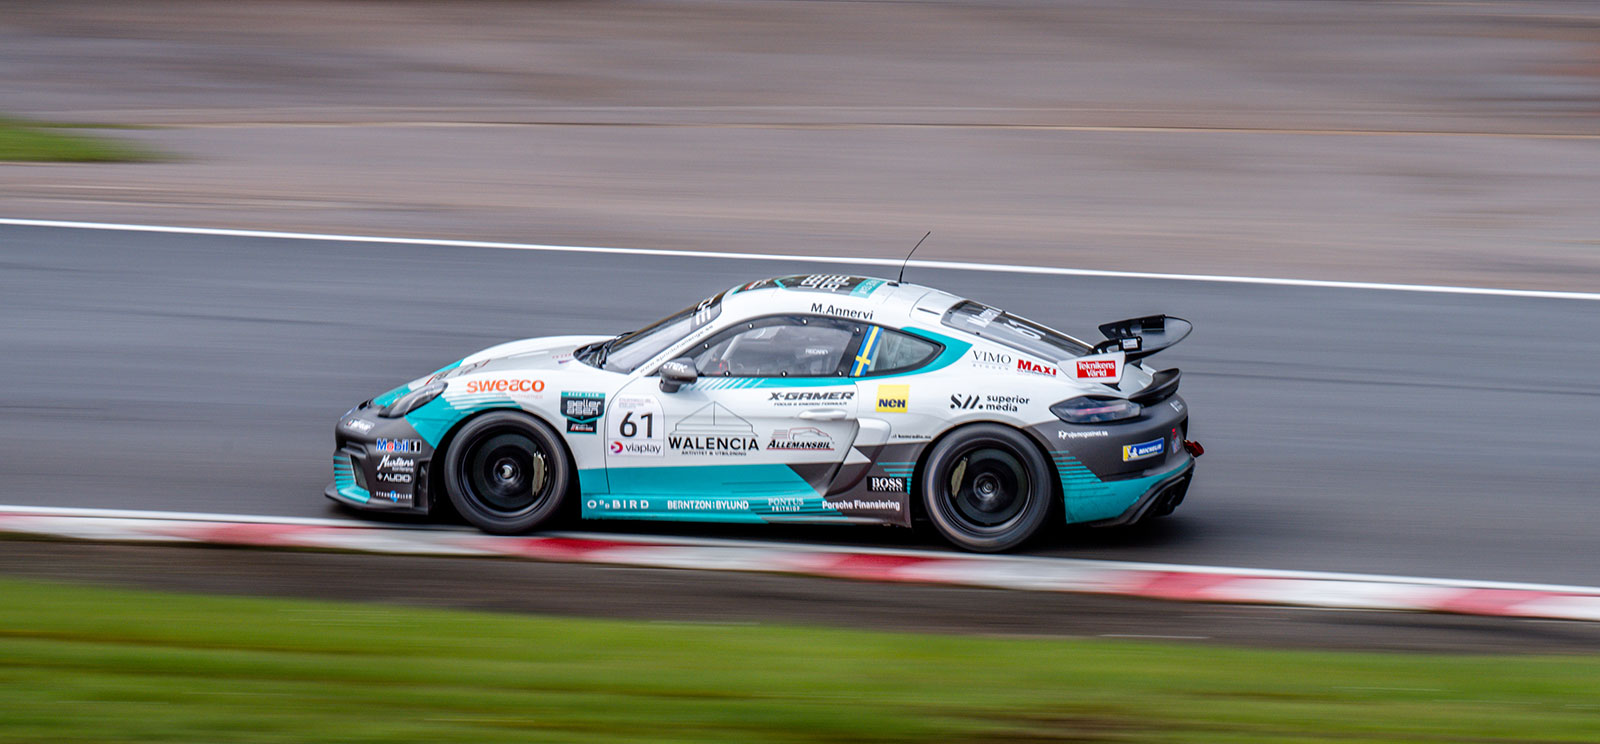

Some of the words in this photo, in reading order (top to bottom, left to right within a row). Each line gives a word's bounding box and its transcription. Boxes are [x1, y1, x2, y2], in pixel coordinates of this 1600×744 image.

[810, 302, 874, 320] M.Annervi
[973, 350, 1012, 364] VIMO
[1017, 359, 1057, 376] MAXI
[1078, 361, 1115, 370] Teknikens
[466, 379, 545, 393] sweaco
[768, 391, 855, 401] X-GAMER
[986, 395, 1030, 405] superior
[985, 403, 1018, 412] media
[619, 411, 653, 438] 61
[377, 438, 409, 452] Mobil
[625, 444, 661, 454] viaplay
[668, 436, 759, 450] WALENCIA
[767, 438, 831, 449] ALLEMANSBIL
[872, 477, 903, 489] BOSS
[822, 501, 853, 510] Porsche
[854, 500, 900, 511] Finansiering
